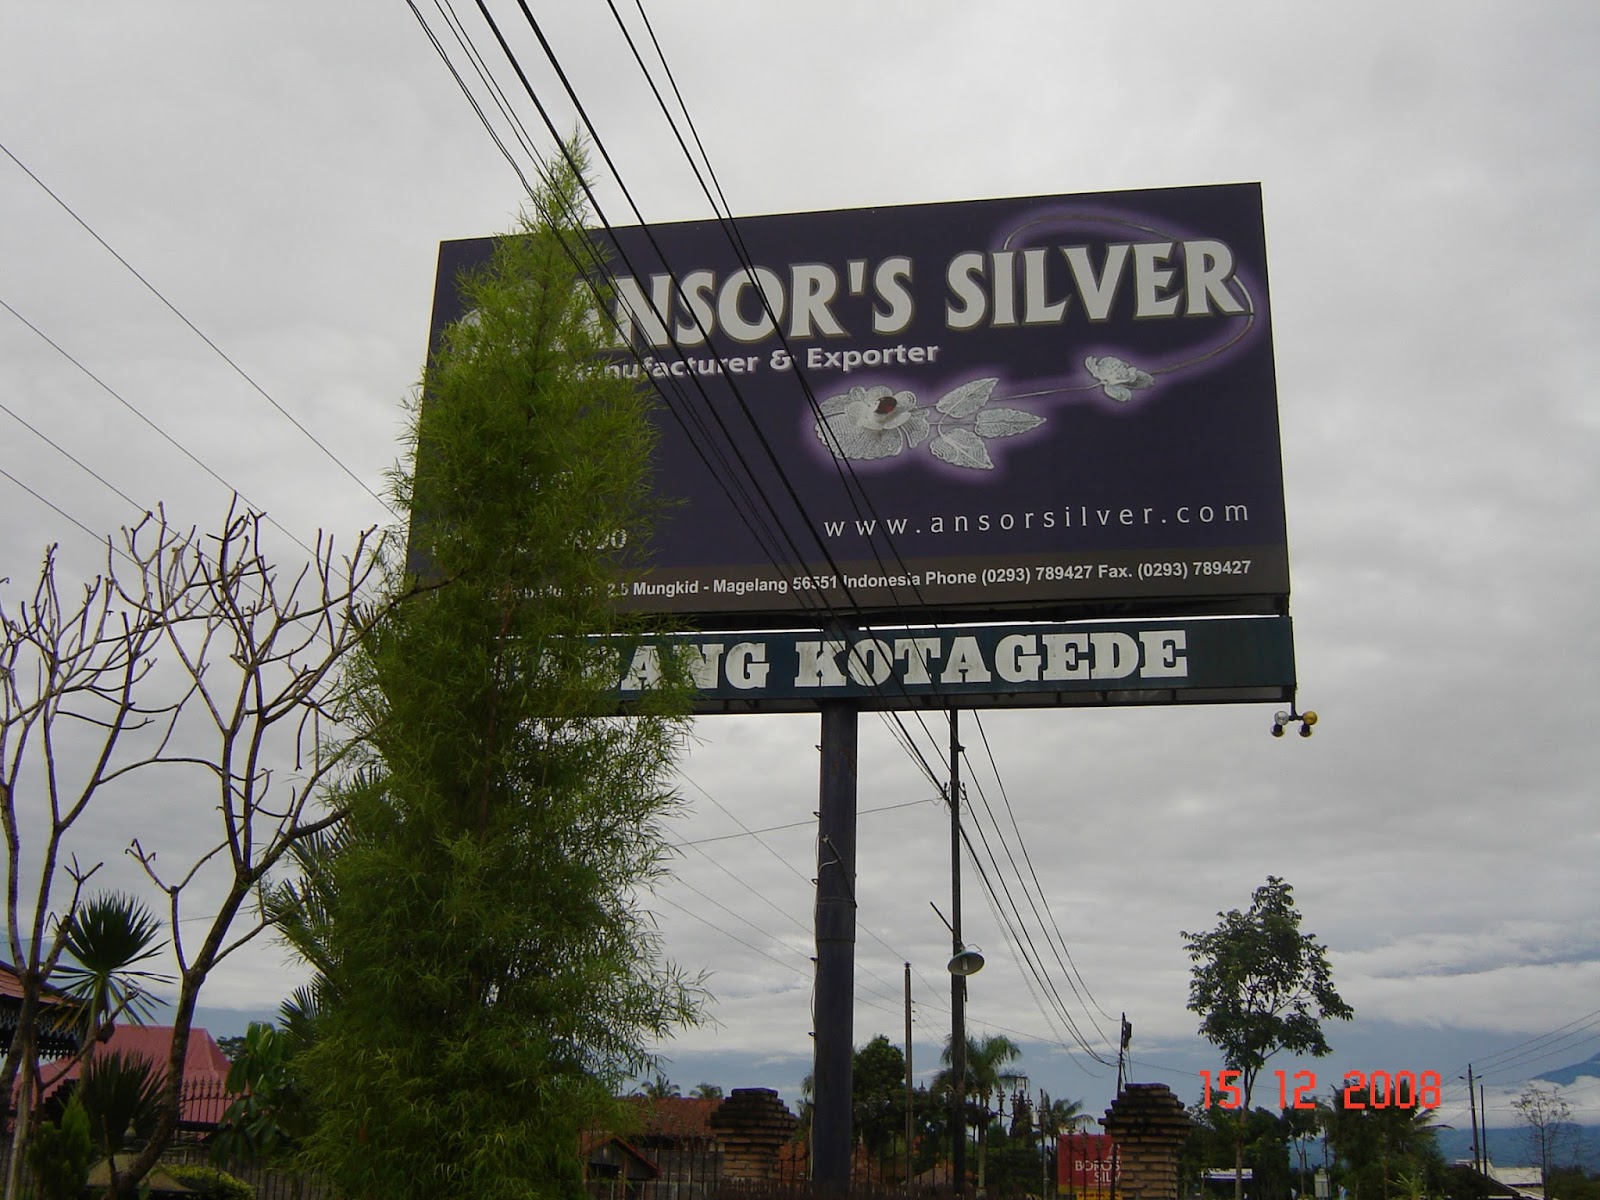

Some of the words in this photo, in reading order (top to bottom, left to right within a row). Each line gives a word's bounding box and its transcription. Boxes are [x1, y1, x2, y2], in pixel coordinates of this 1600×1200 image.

[945, 239, 1246, 330] SILVER
[769, 349, 793, 370] &
[806, 343, 940, 372] Exporter
[823, 503, 1249, 537] www.ansorsilver.com
[632, 580, 700, 599] Mungkid
[713, 577, 788, 596] Magelang
[792, 575, 837, 591] 56551
[925, 570, 977, 586] Phone
[981, 566, 1031, 586] (0293)
[1035, 565, 1093, 581] 789427
[1097, 564, 1133, 580] Fax.
[1137, 561, 1188, 581] (0293)
[1192, 560, 1252, 576] 789427
[794, 629, 1188, 688] KOTAGEDE
